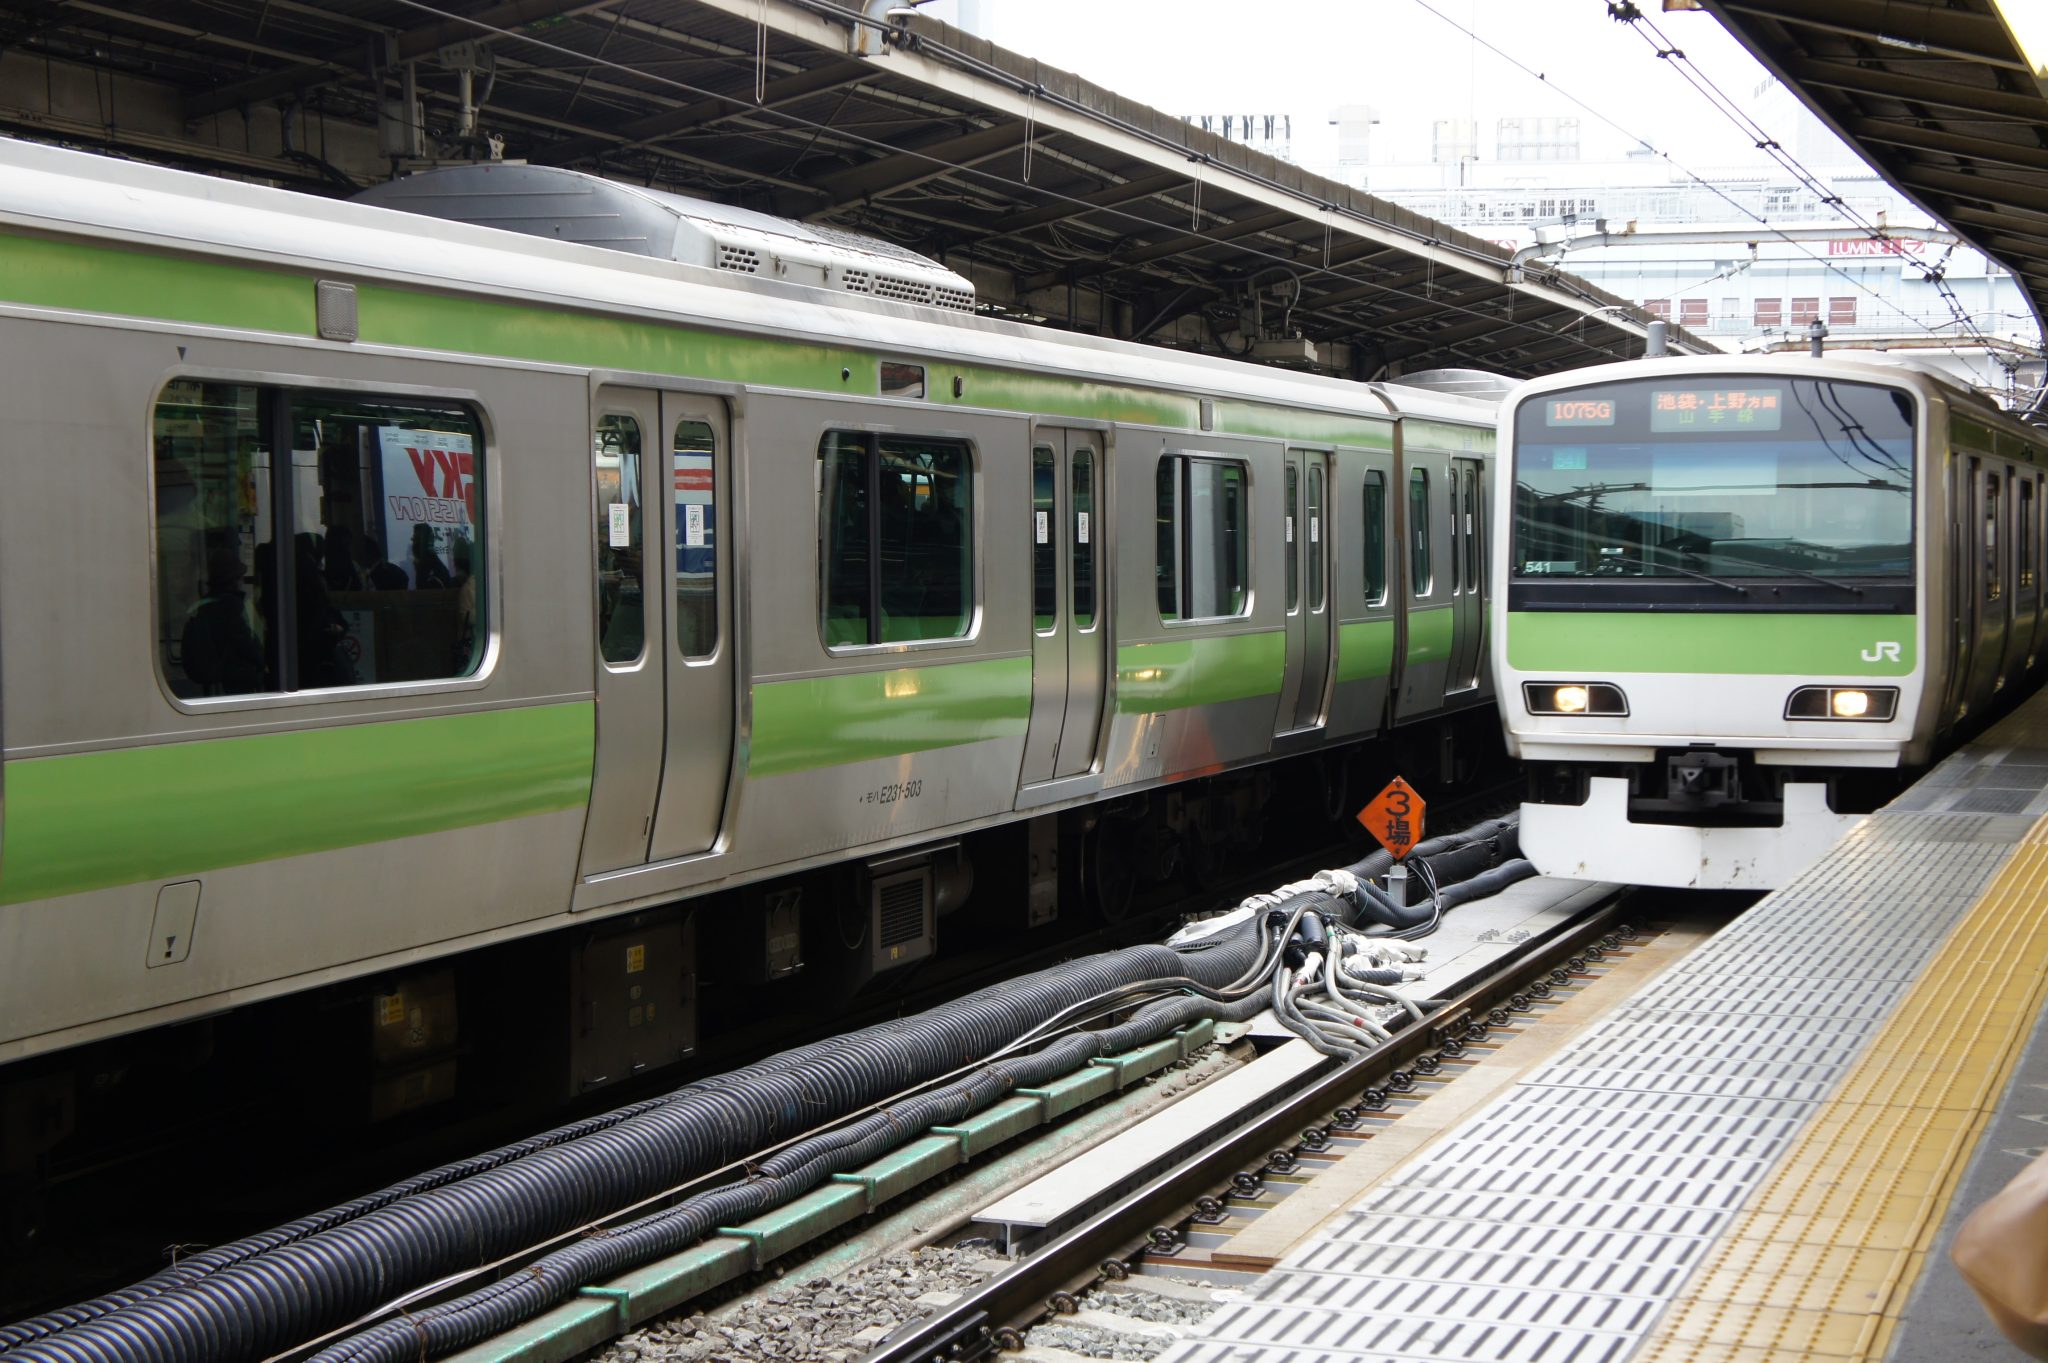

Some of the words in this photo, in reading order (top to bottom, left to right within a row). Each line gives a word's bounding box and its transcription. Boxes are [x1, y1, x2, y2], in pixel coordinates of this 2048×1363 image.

[1833, 240, 1885, 255] LUMINE
[1657, 392, 1777, 410] 池袋・上野方面
[1554, 402, 1611, 420] 1075G
[1679, 409, 1754, 424] 山手線
[1525, 561, 1551, 573] 541
[1861, 641, 1901, 662] JR
[1385, 791, 1410, 817] 3
[1386, 816, 1411, 845] 場
